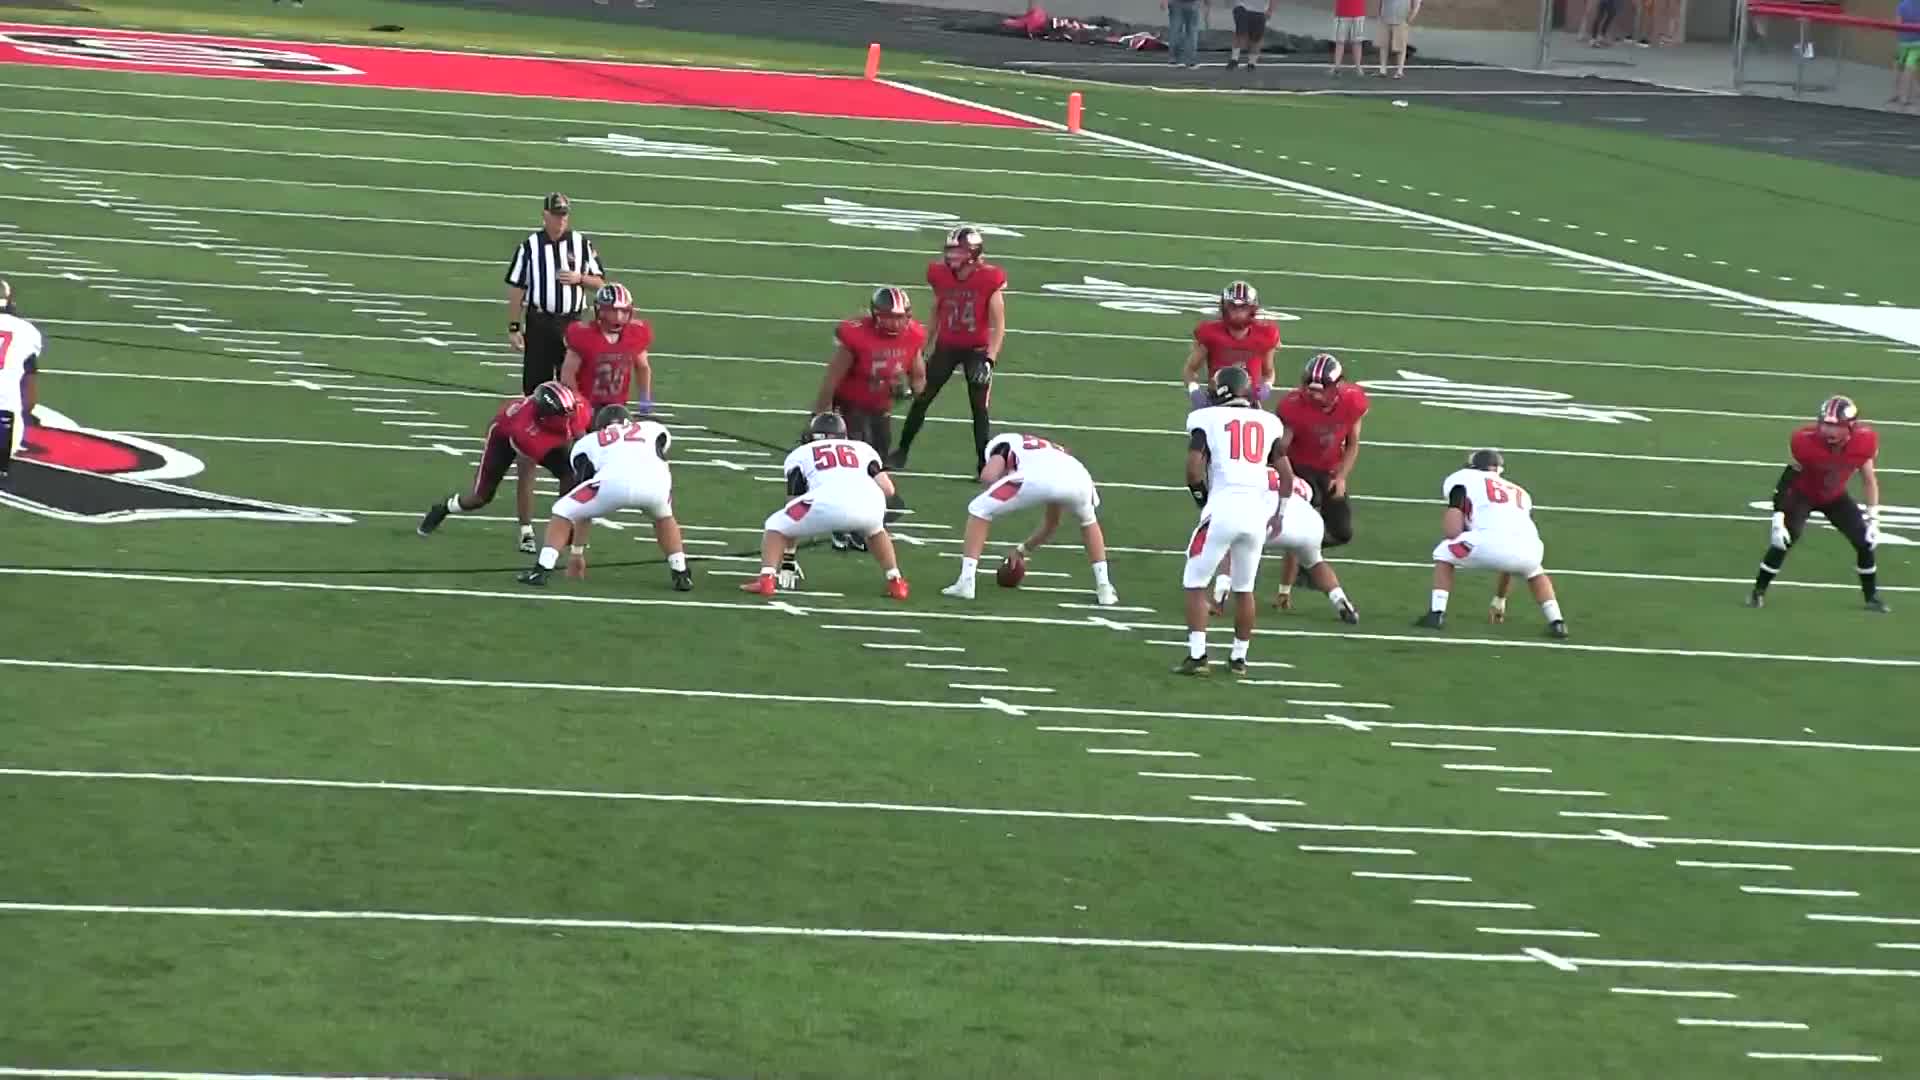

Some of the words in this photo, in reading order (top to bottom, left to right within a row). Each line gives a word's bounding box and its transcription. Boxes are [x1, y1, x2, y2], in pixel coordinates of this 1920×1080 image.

[597, 422, 646, 448] 62
[1223, 418, 1265, 464] 10
[812, 443, 860, 471] 56
[1484, 477, 1524, 510] 67
